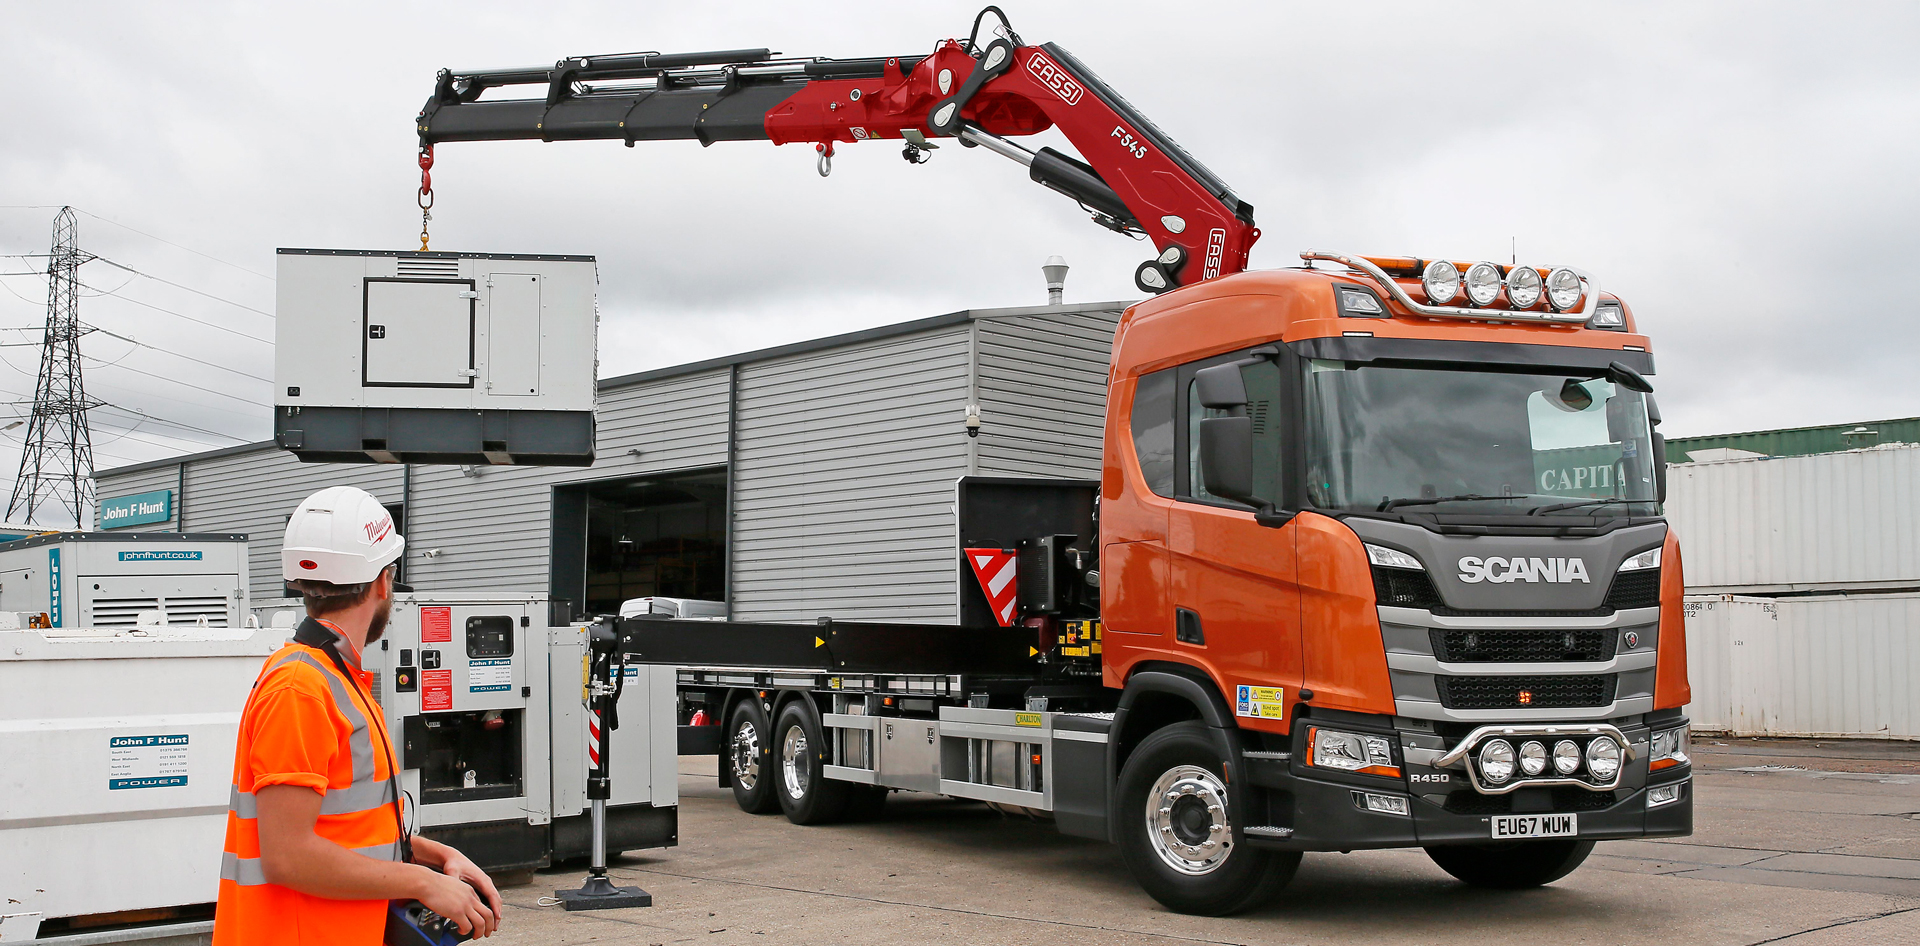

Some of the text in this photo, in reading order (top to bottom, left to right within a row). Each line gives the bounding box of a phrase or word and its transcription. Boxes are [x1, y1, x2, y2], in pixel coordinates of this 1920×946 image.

[1030, 56, 1080, 102] FASSI
[1110, 125, 1148, 159] F545
[1206, 233, 1222, 279] FASS
[103, 501, 164, 520] John F Hunt
[123, 551, 198, 561] johnfhunt.co.uk
[1457, 556, 1591, 583] SCANIA
[51, 558, 59, 623] John
[1016, 714, 1041, 723] CHARLTON
[112, 738, 143, 746] John
[118, 779, 180, 787] POWER
[1410, 774, 1450, 783] R450
[1497, 815, 1571, 836] EU67 WUW
